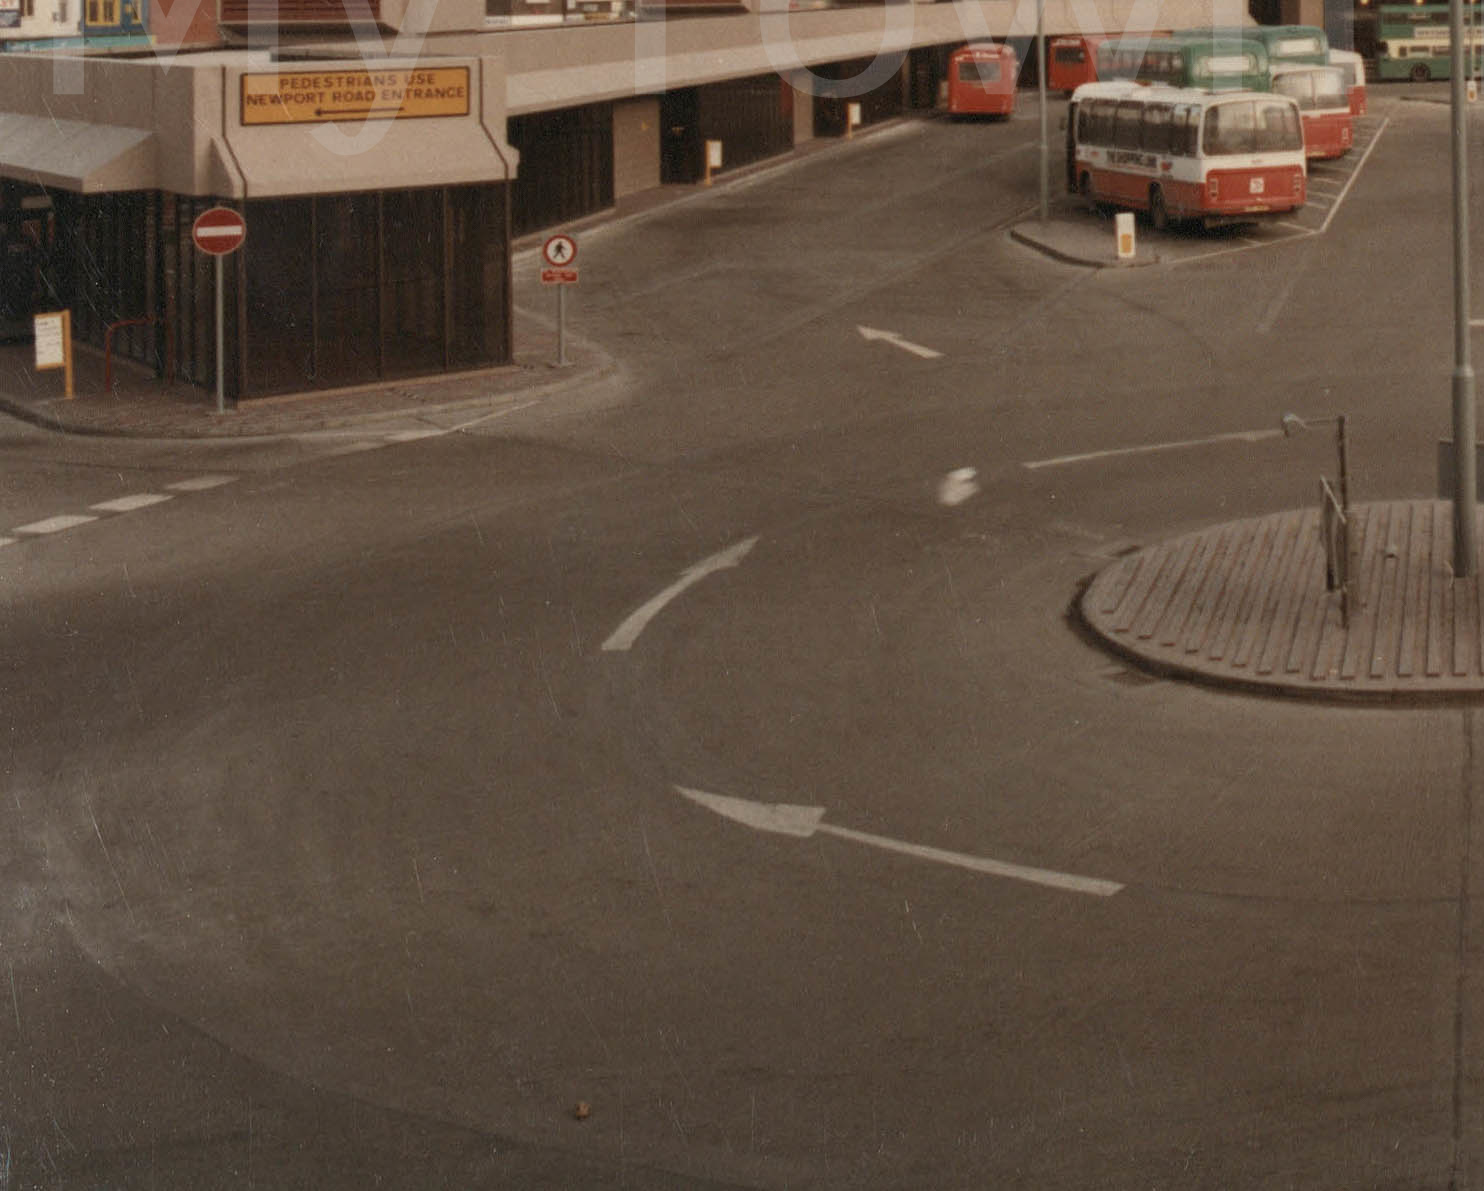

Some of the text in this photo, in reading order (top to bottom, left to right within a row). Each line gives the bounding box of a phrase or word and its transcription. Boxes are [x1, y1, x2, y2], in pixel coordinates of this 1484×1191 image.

[278, 72, 437, 91] PEDESTRIANS USE
[246, 86, 466, 107] NEWPORT ROAD ENTRANCE
